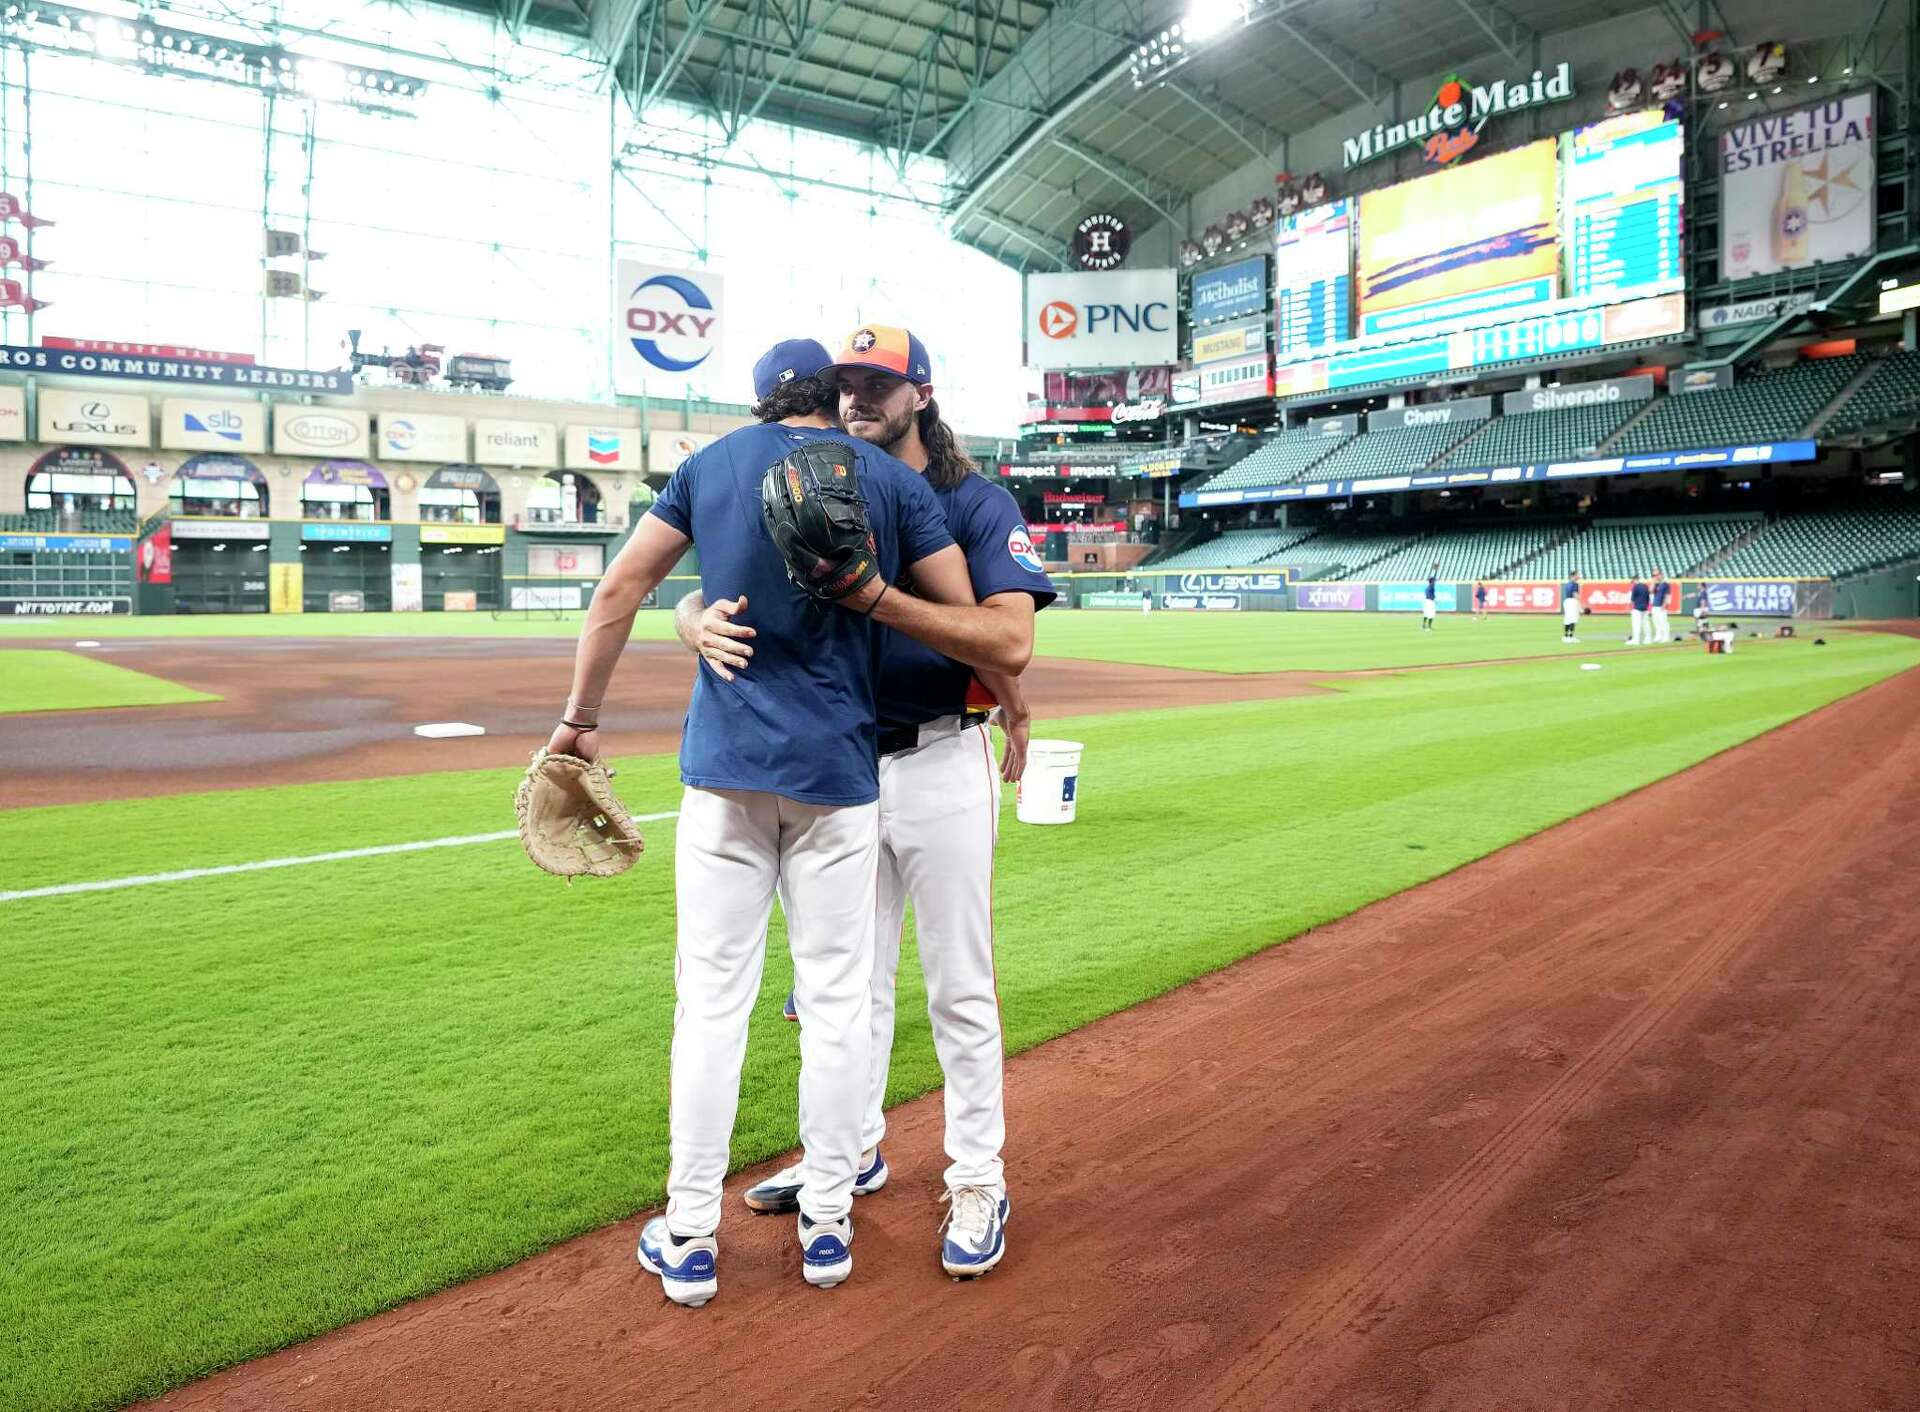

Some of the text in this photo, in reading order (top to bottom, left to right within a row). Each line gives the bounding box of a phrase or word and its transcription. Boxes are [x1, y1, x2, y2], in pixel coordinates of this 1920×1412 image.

[1706, 53, 1721, 75] 5
[1343, 62, 1572, 169] Minute Maid
[1723, 116, 1872, 174] ESTRELLA!
[1078, 214, 1124, 233] HOUSTON
[1090, 231, 1111, 252] H
[1081, 251, 1121, 268] ASTROS
[1083, 302, 1169, 334] PNC
[1732, 295, 1801, 320] NABOS
[626, 307, 716, 338] OXY
[60, 354, 225, 381] COMMUNITY
[235, 368, 338, 389] LEADERS
[1532, 382, 1620, 411] Silverado
[207, 409, 243, 430] slb
[1403, 407, 1451, 427] Chevy
[52, 420, 137, 436] LEXUS
[487, 432, 540, 448] reliant
[1069, 464, 1116, 479] impact
[1043, 491, 1106, 504] Budweiser
[1010, 541, 1033, 554] OX
[1205, 573, 1281, 591] LEXUS
[1308, 587, 1352, 608] xfinity
